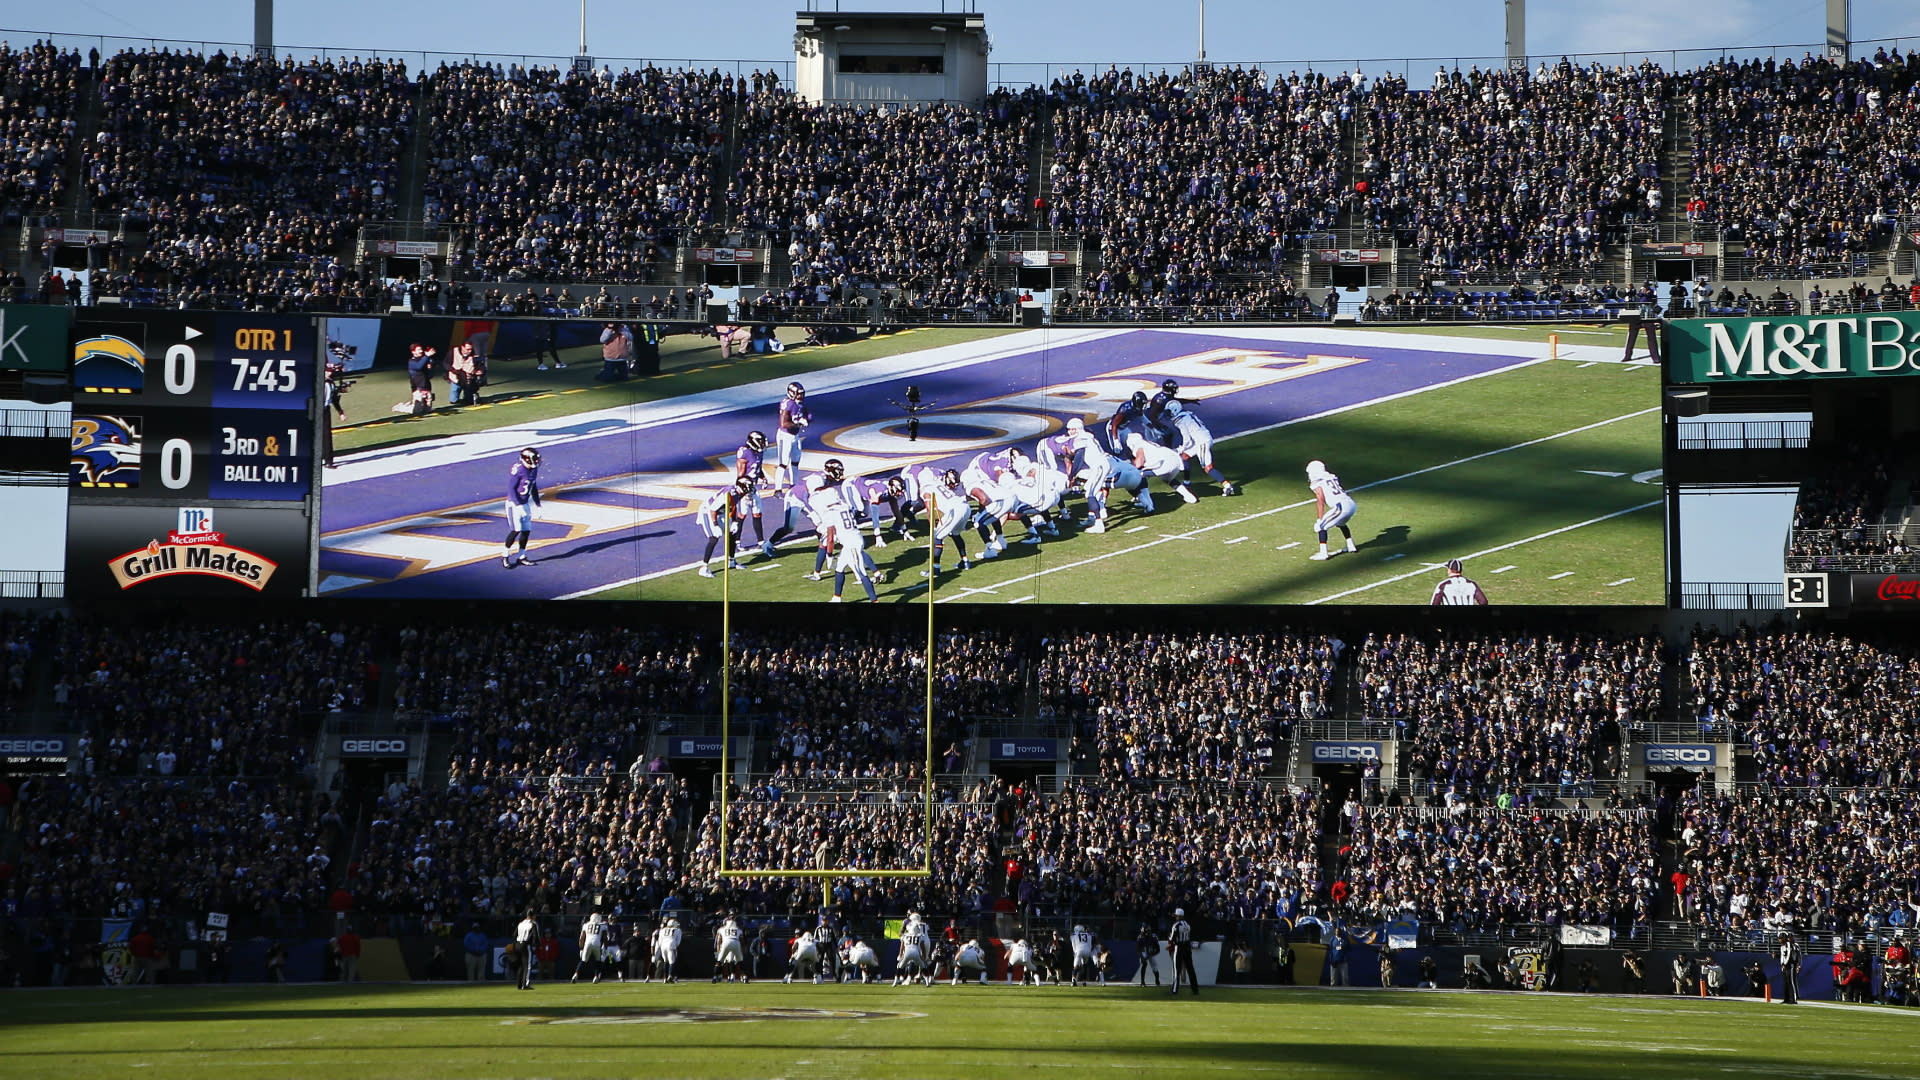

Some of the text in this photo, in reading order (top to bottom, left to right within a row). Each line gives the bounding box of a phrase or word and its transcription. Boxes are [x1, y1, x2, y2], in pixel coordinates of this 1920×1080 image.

[235, 328, 292, 351] QTR 1
[1704, 318, 1857, 376] M&T
[164, 344, 196, 394] 0
[231, 358, 297, 392] 7:45
[221, 427, 298, 457] 3RD & 1
[161, 438, 192, 489] 0
[224, 465, 298, 483] BALL ON 1
[170, 533, 219, 544] McCormick
[122, 547, 263, 582] Grill Mates
[1790, 578, 1822, 602] 21
[0, 740, 63, 752] GEICO
[343, 740, 405, 752] GEICO
[1315, 746, 1377, 758] GEICO
[1646, 748, 1711, 761] GEICO
[1079, 933, 1088, 942] 13
